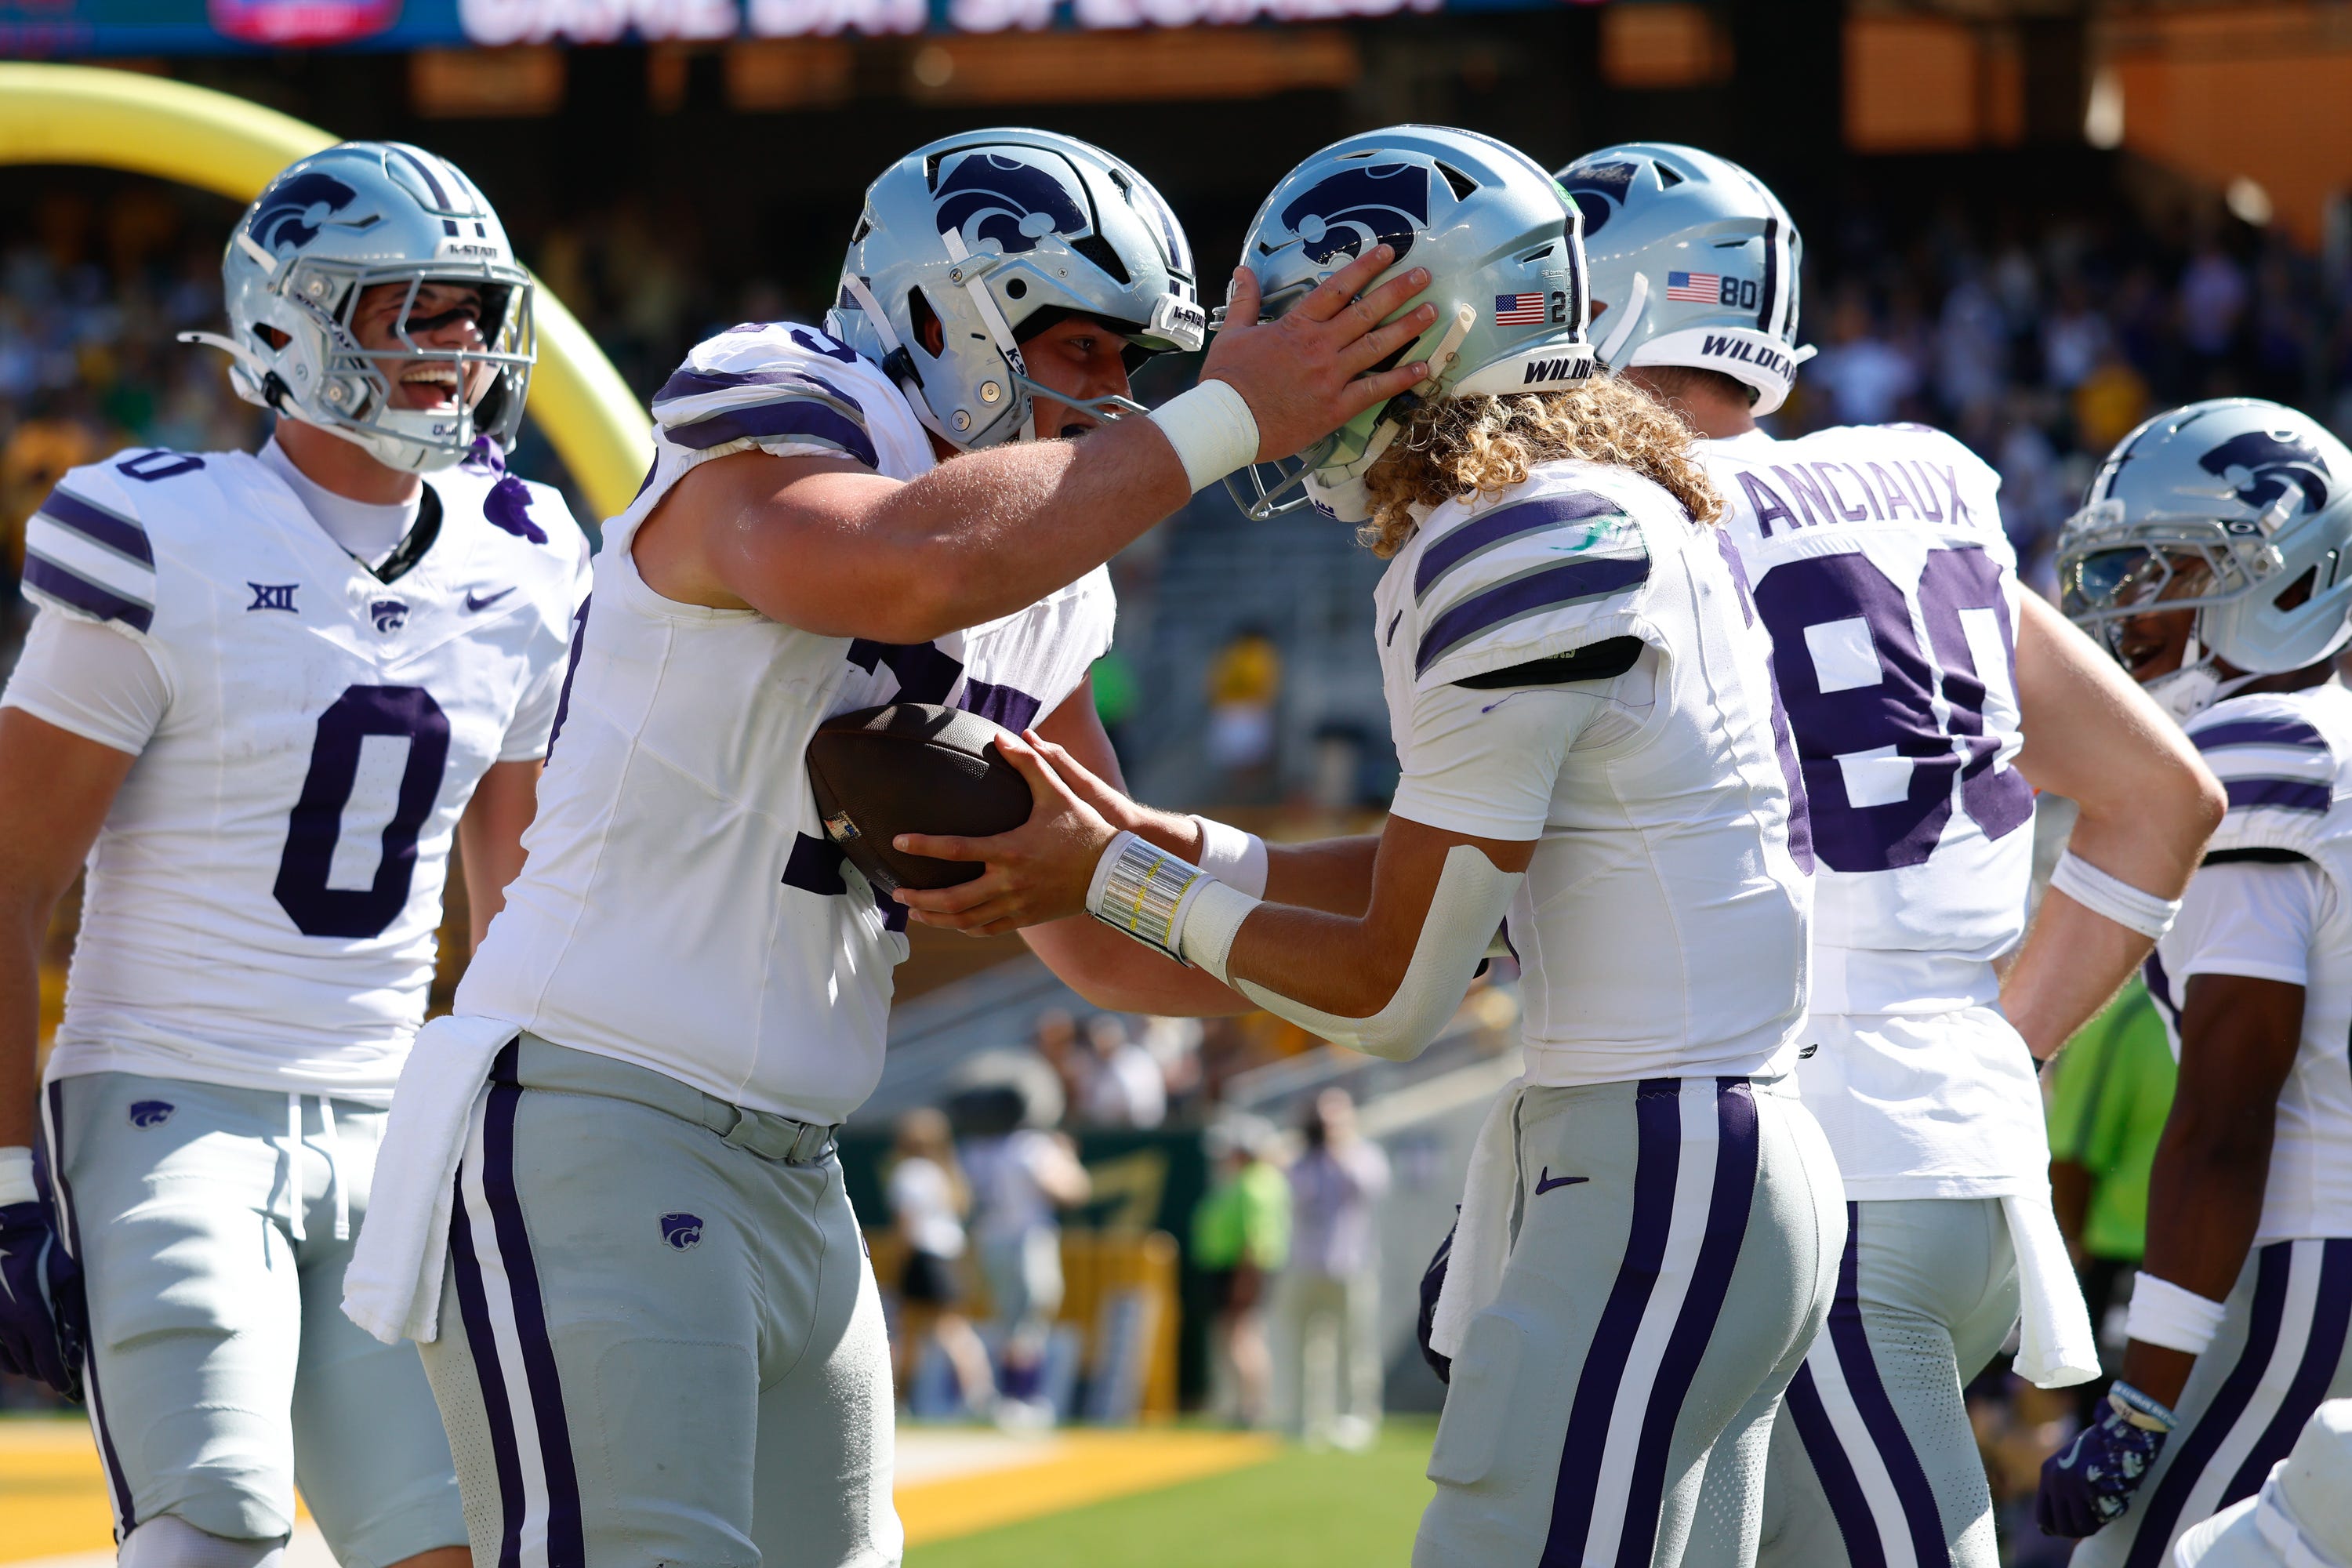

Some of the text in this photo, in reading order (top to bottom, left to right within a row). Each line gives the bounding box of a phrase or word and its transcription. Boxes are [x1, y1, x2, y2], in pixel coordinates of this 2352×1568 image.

[1552, 291, 1566, 323] 2
[1720, 276, 1756, 310] 80
[1735, 459, 1977, 539] ANCIAUX
[246, 581, 299, 615] XII
[1753, 546, 2035, 873] 80
[272, 684, 451, 939] 0
